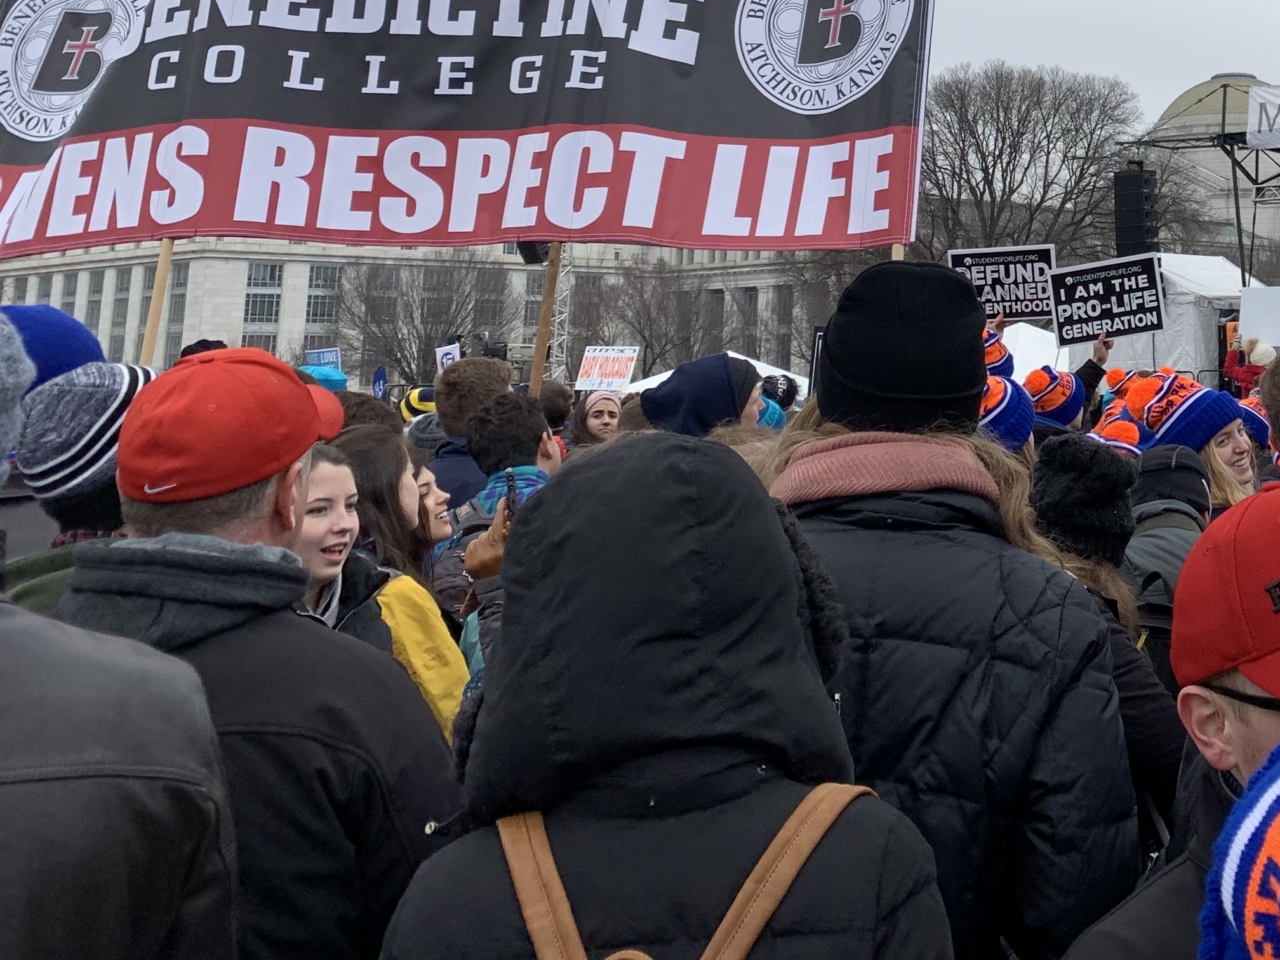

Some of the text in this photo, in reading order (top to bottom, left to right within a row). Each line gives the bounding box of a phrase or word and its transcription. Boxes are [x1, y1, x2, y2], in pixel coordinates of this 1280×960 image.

[148, 44, 607, 96] COLLEGE
[745, 32, 897, 107] ATCHISON, KANSAS
[233, 124, 688, 234] RESPECT
[701, 133, 895, 237] LIFE
[971, 254, 1039, 265] STUDENTSFORLIFE.ORG
[955, 262, 1050, 286] DEFUND
[1072, 265, 1142, 283] STUDENTSFORLIFE.ORG
[978, 282, 1050, 303] ANNED
[1060, 274, 1149, 301] I AM THE
[984, 300, 1052, 315] ENTHOOD
[1057, 289, 1158, 322] PRO-LIFE
[1062, 311, 1158, 340] GENERATION
[320, 351, 337, 363] LOVE
